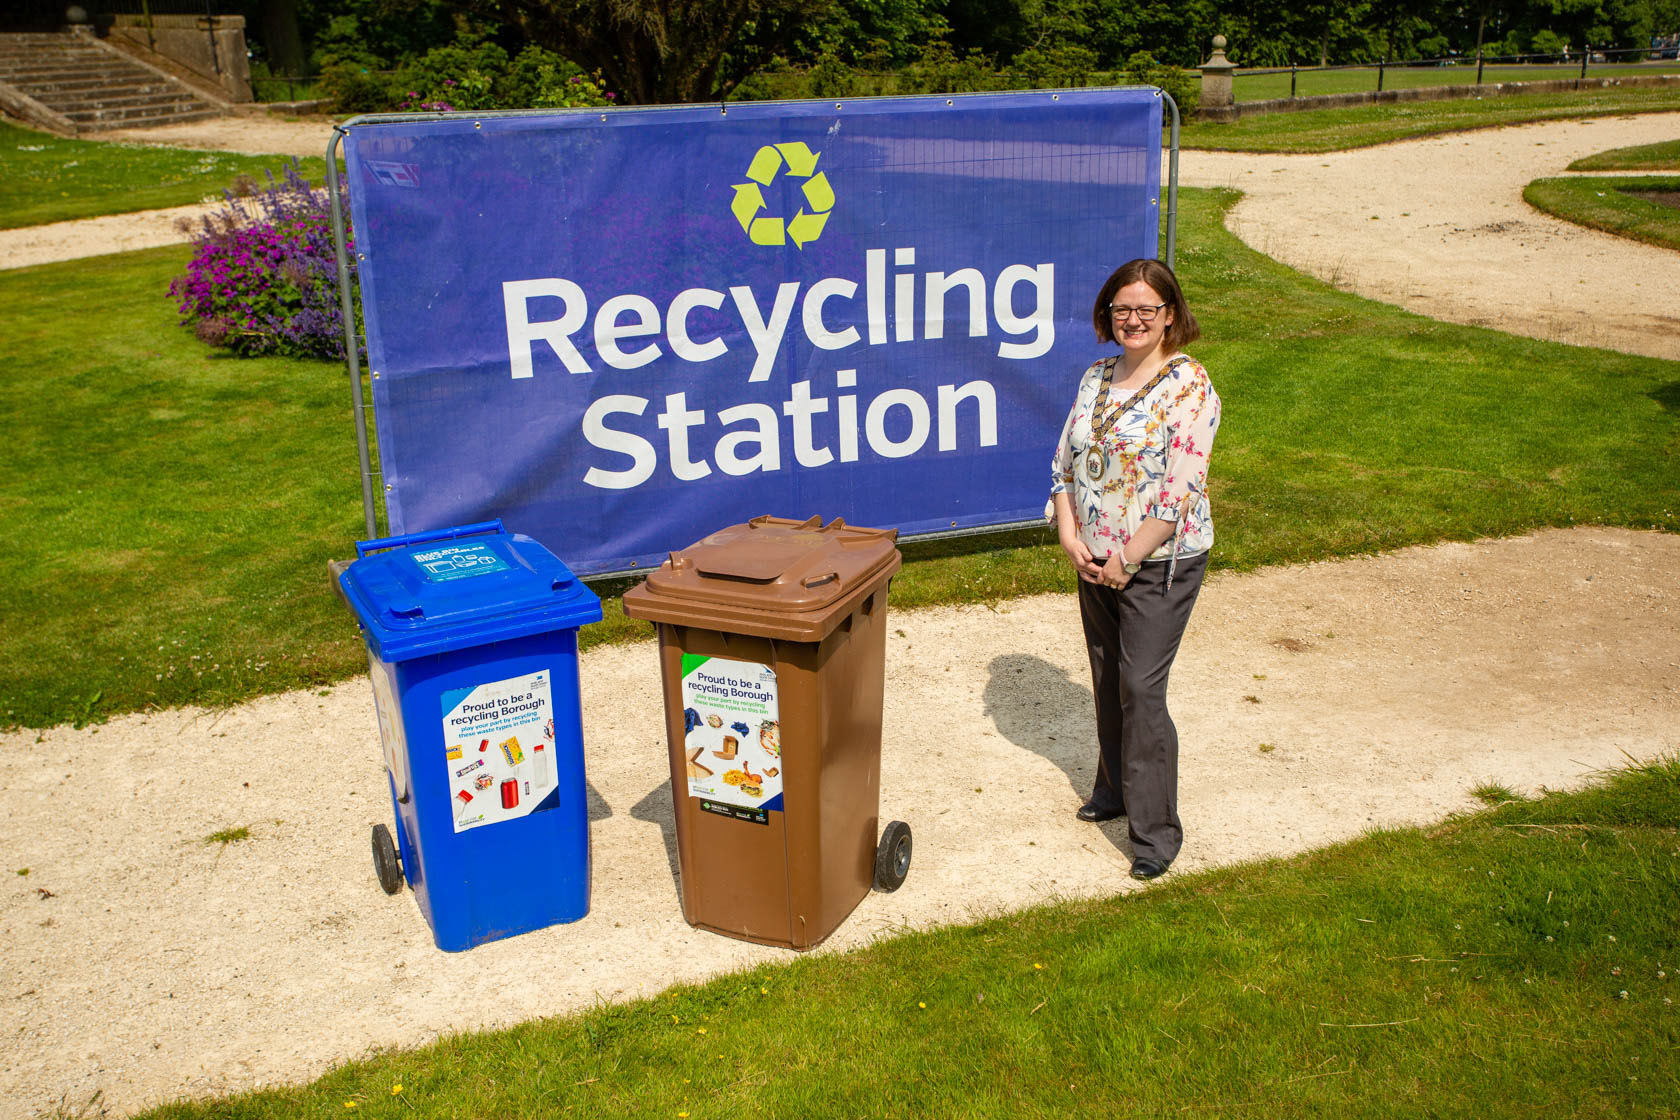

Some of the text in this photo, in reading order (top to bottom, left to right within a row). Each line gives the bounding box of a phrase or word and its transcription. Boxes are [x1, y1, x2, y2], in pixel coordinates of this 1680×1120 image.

[503, 248, 1054, 382] Recycling
[582, 369, 998, 489] Station
[698, 672, 725, 685] Proud
[727, 677, 737, 686] to
[740, 678, 752, 688] be
[688, 681, 773, 702] recycling Borough
[451, 697, 545, 726] recycling Borough
[463, 692, 532, 713] Proud to be a
[741, 701, 765, 709] recycling
[490, 719, 502, 727] part
[512, 711, 538, 720] recycling
[496, 723, 512, 731] types
